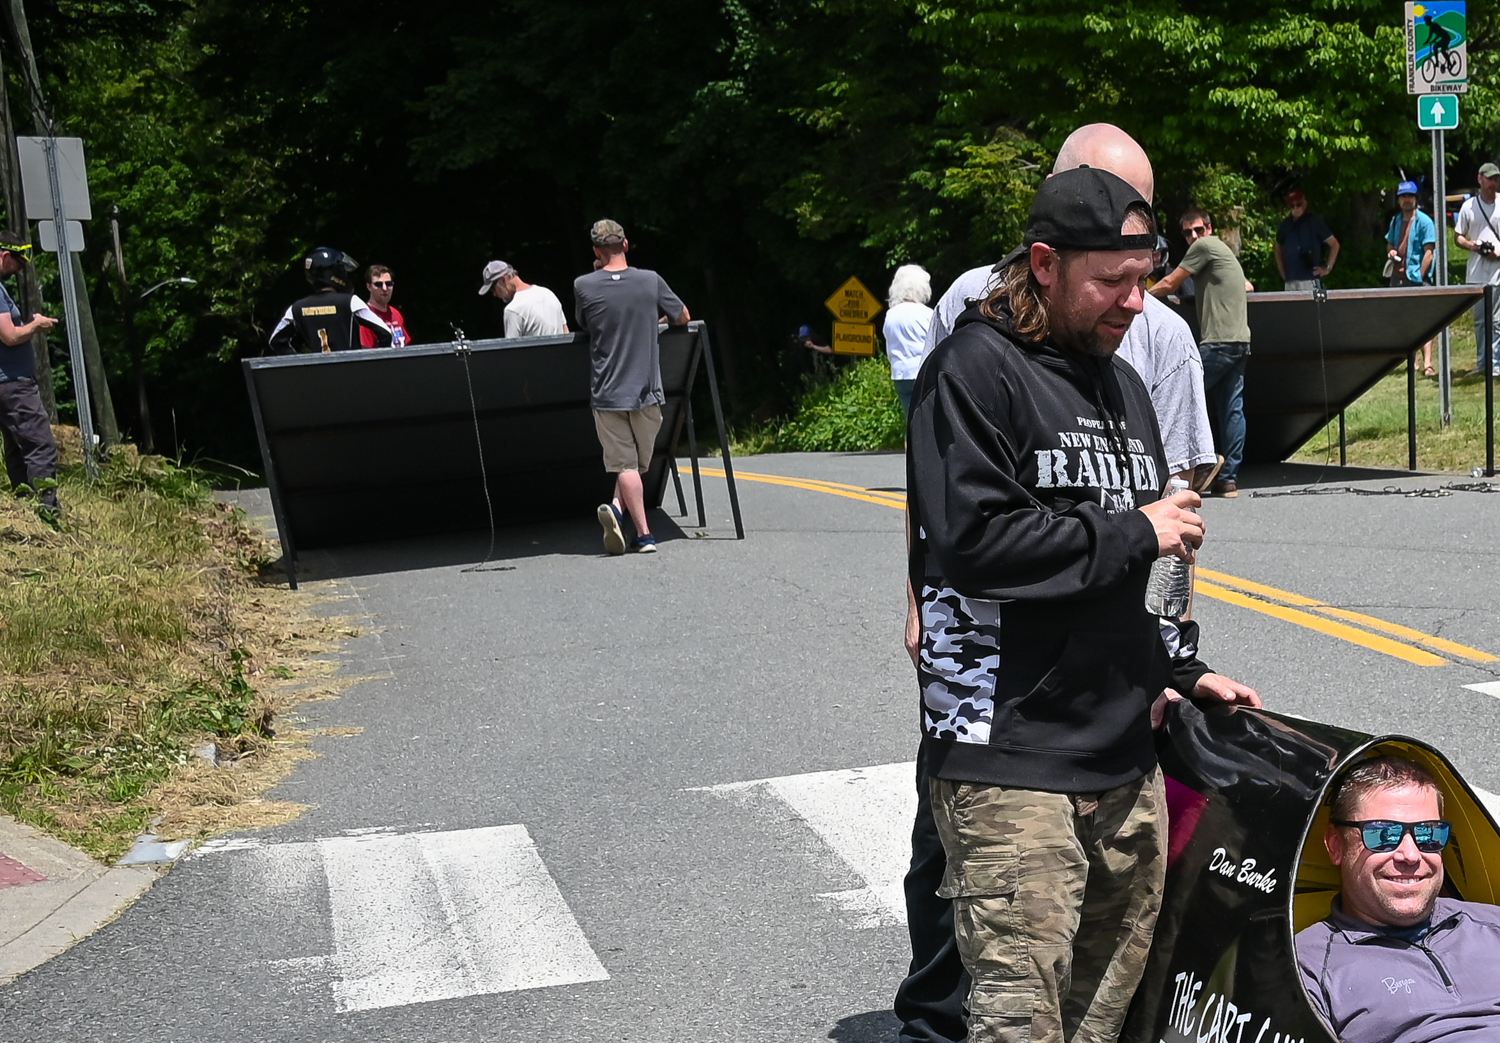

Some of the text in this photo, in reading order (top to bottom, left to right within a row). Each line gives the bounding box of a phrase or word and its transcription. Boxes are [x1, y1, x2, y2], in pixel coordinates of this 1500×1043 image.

[1430, 84, 1463, 92] BIKEWAY
[835, 333, 872, 344] PLAYGROUND
[1058, 432, 1091, 448] NEW
[1209, 847, 1277, 895] Dan Burke
[1169, 971, 1203, 1036] THE
